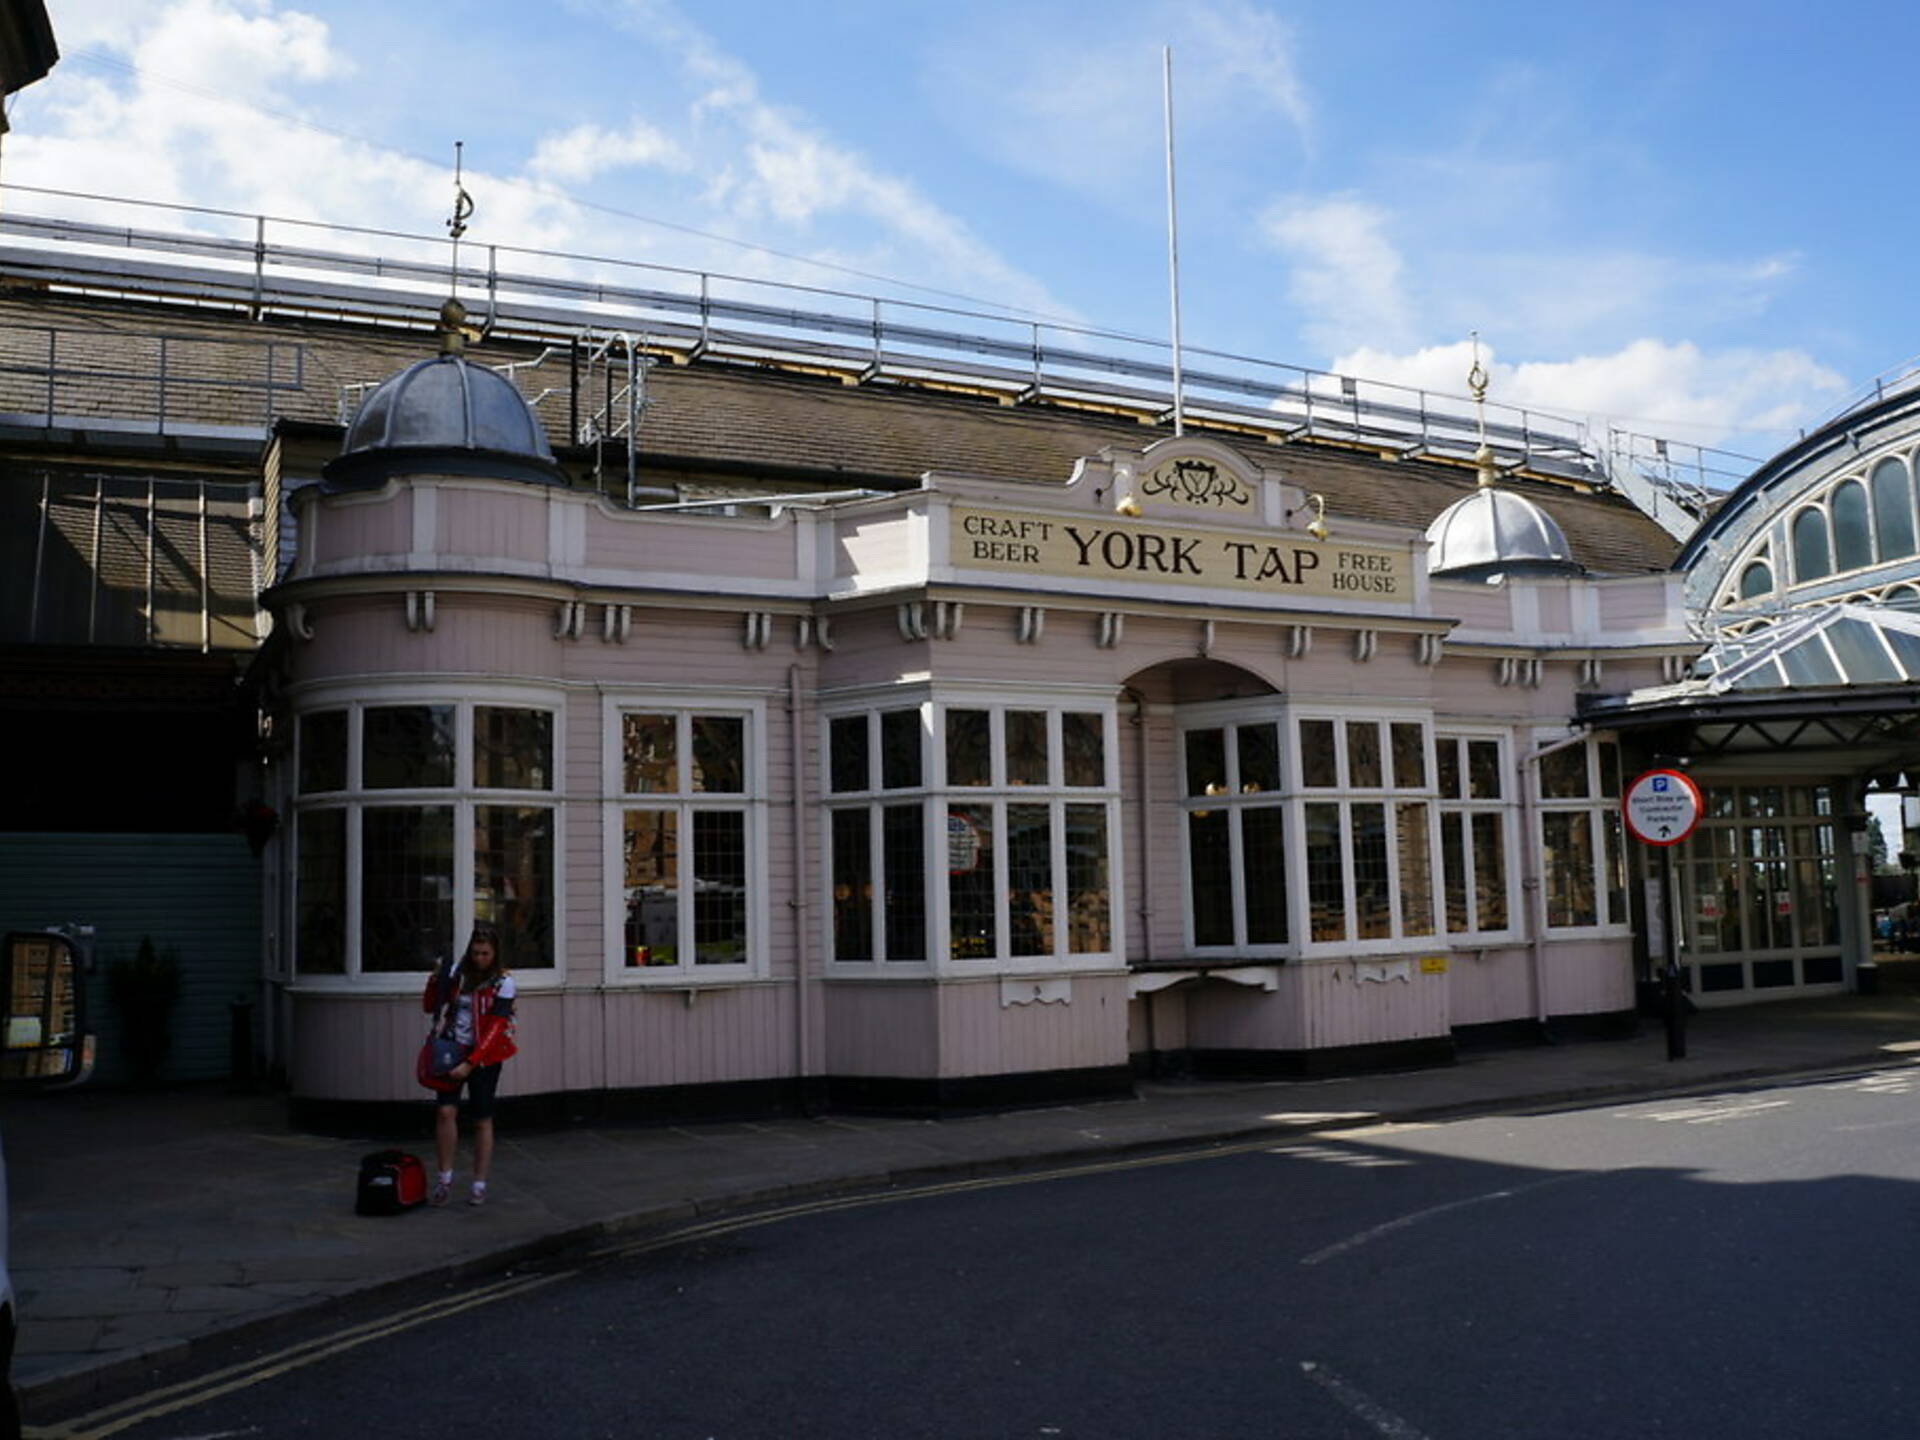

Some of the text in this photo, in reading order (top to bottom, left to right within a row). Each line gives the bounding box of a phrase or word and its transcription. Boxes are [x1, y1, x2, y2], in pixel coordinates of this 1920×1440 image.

[963, 515, 1054, 541] CRAFT
[974, 540, 1040, 563] BEER
[1064, 526, 1320, 584] YORK TAP
[1338, 551, 1393, 572] FREE
[1332, 572, 1397, 593] HOUSE
